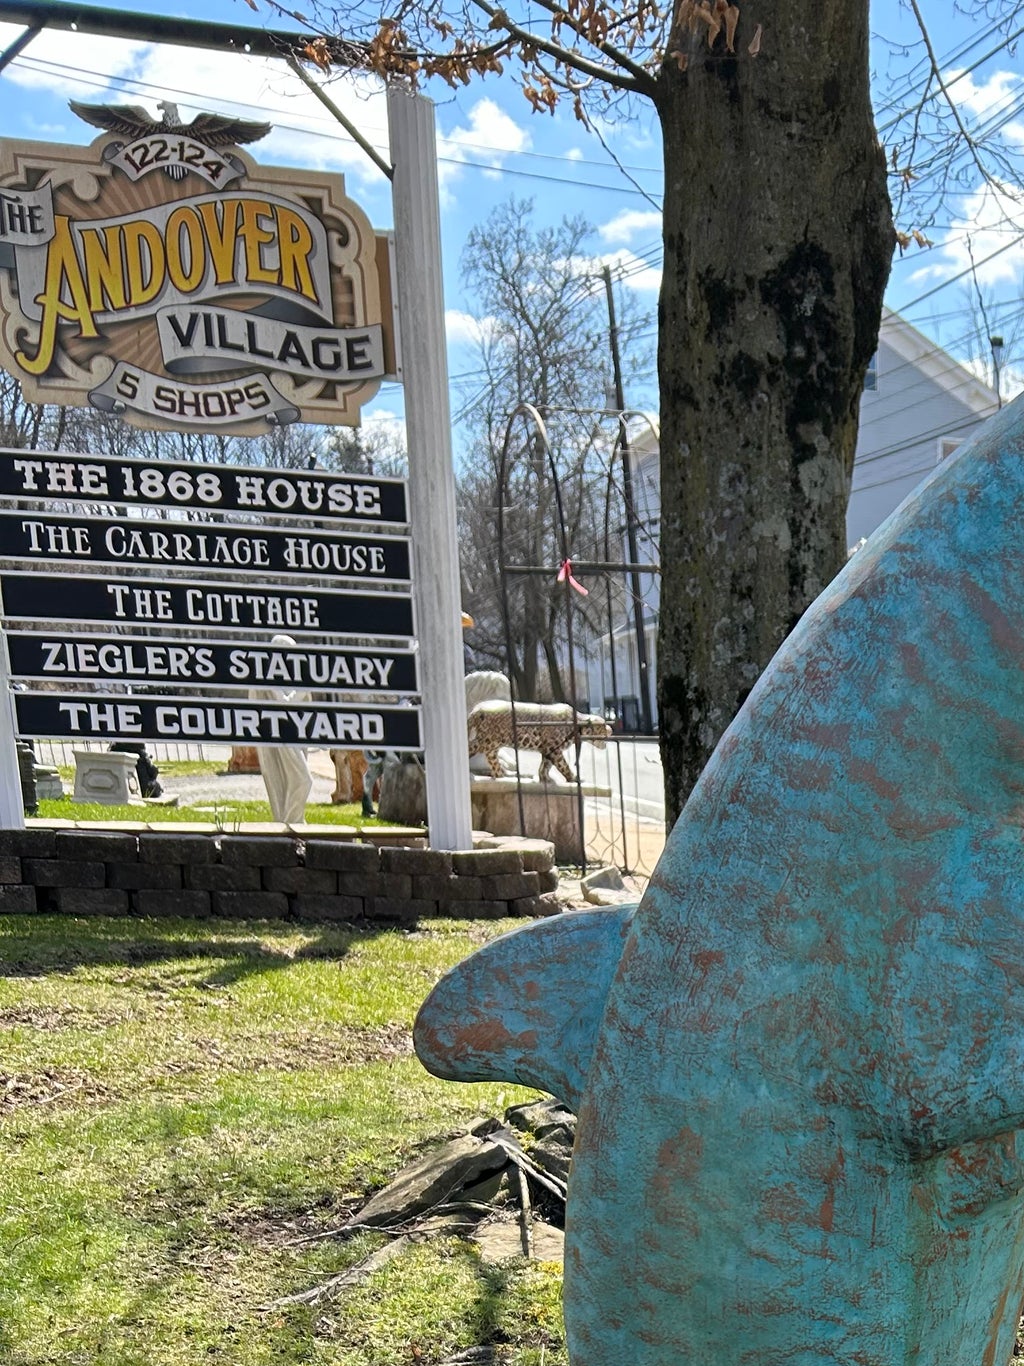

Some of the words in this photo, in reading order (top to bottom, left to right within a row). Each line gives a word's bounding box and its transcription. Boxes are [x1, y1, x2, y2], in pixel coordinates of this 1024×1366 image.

[123, 139, 228, 181] 122-124
[14, 199, 321, 377] ANDOVER
[166, 311, 375, 372] VILLAGE
[116, 371, 141, 401] 5
[152, 381, 272, 419] SHOPS
[14, 459, 109, 495] THE
[122, 465, 224, 502] 1868
[235, 475, 382, 516] HOUSE
[22, 520, 92, 555] THE
[105, 525, 271, 566] CARRIAGE
[283, 536, 387, 574] HOUSE
[107, 584, 173, 620] THE
[186, 588, 320, 628] COTTAGE
[41, 641, 218, 679] ZIEGLER'S
[229, 650, 395, 687] STATUARY
[59, 702, 142, 733] THE
[155, 706, 385, 741] COURTYARD
